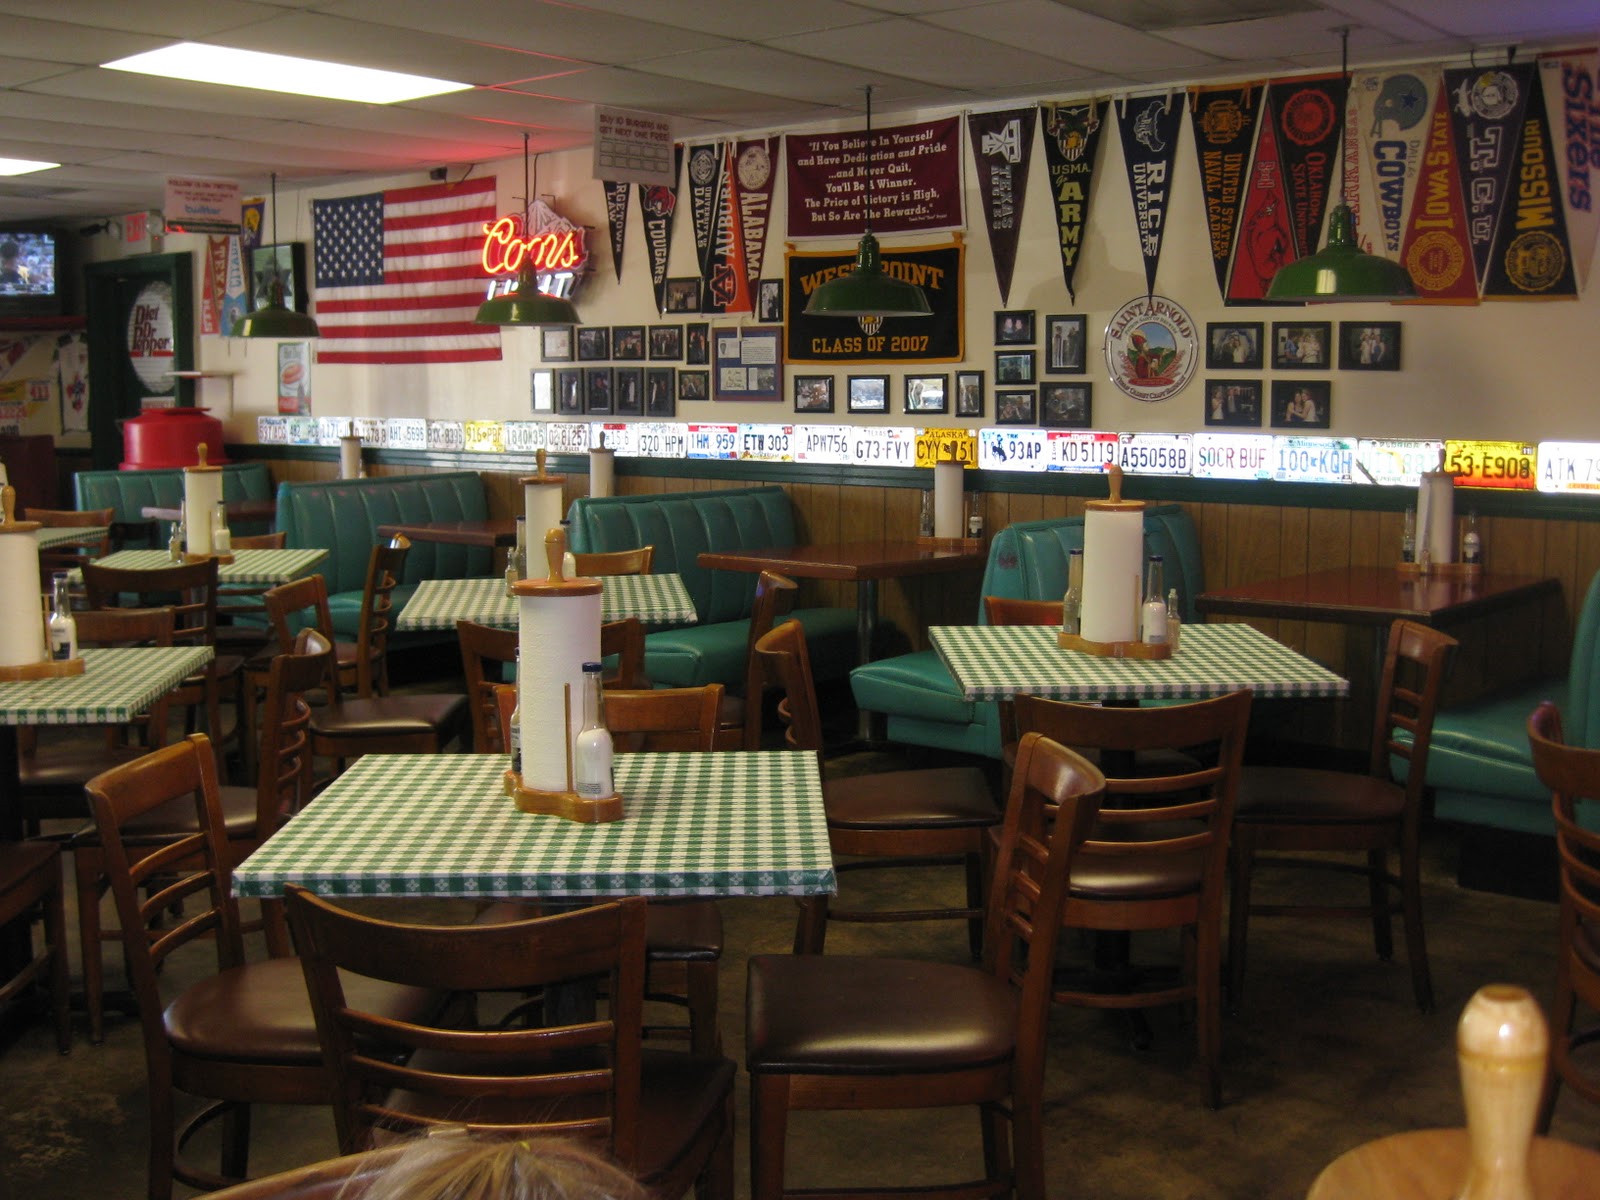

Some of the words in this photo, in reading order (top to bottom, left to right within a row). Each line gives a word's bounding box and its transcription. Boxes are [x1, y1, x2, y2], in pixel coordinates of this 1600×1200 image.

[599, 126, 612, 134] GET
[615, 128, 631, 137] NEXT
[634, 131, 648, 139] ONE
[822, 141, 840, 151] You
[842, 138, 876, 150] Beliee
[879, 133, 889, 145] In
[892, 129, 934, 144] Yourself
[797, 155, 815, 166] and
[816, 156, 841, 166] Have
[898, 146, 916, 158] and
[918, 143, 947, 156] Pride
[1407, 139, 1421, 179] DALLAS
[826, 182, 851, 193] You'll
[853, 182, 865, 192] Be
[877, 178, 917, 189] Winner.
[1203, 151, 1222, 192] NAVAL
[1222, 153, 1243, 204] UNITED
[1290, 162, 1307, 198] STATE
[1516, 119, 1554, 230] MISSOURI
[804, 198, 821, 208] The
[823, 197, 848, 208] Price
[851, 195, 861, 206] of
[901, 192, 910, 202] is
[999, 165, 1014, 229] TEXAS
[1304, 152, 1327, 225] OKLAHOMA
[1373, 140, 1408, 252] COWBOYS
[607, 191, 617, 222] LAW
[693, 186, 705, 248] DALLAS
[703, 185, 712, 235] UNIVERSITY
[715, 170, 737, 258] AUBURN
[811, 212, 826, 222] But
[828, 211, 840, 221] So
[843, 209, 860, 220] Are
[1133, 162, 1151, 256] UNIVERSITY
[1147, 160, 1167, 257] RICE
[740, 192, 769, 282] ALABAMA
[1058, 181, 1084, 267] ARMY
[1208, 197, 1223, 261] ACADEMY
[1221, 207, 1234, 257] STATES
[647, 219, 666, 285] COUGARS
[800, 262, 860, 295] WES
[135, 303, 160, 325] Diet
[1111, 302, 1144, 341] SAINT
[1144, 301, 1192, 339] ARNOLD
[812, 337, 862, 354] CLASS
[867, 336, 886, 352] OF
[891, 335, 929, 352] 2007
[640, 434, 660, 452] 320
[716, 433, 735, 450] 959
[768, 434, 789, 452] 303
[867, 429, 886, 437] TEXAS
[929, 430, 966, 439] ALASKA
[916, 440, 941, 460] CYY
[1008, 440, 1042, 461] 93AP
[1121, 446, 1187, 469] A55058B
[1198, 446, 1235, 469] SOCR
[1239, 447, 1267, 470] BUF
[1278, 449, 1310, 473] 100
[1544, 457, 1576, 481] ATK
